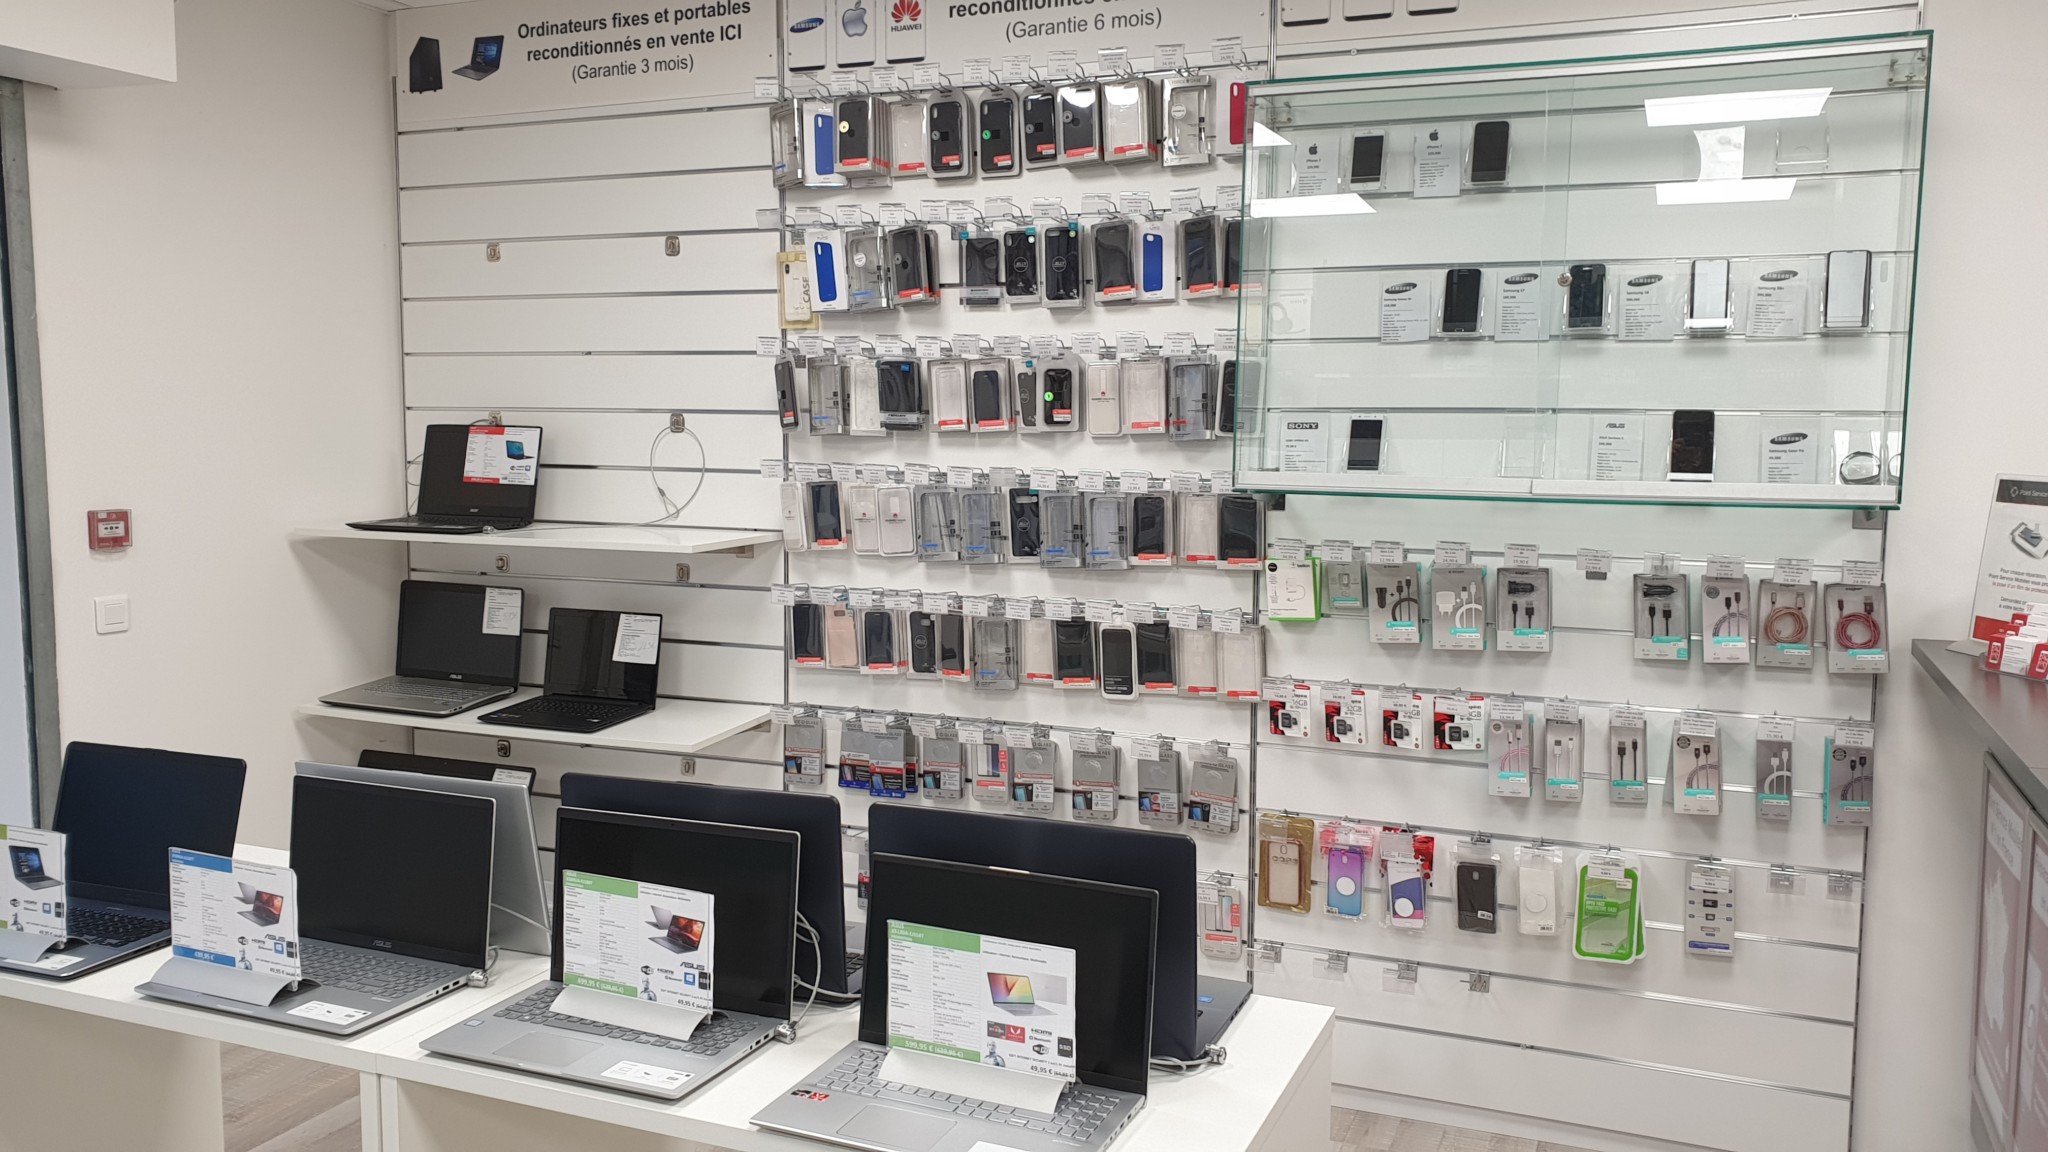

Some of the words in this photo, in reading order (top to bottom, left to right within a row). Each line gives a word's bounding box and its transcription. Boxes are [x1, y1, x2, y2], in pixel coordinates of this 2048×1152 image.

[518, 16, 607, 39] Ordinateurs
[612, 11, 649, 29] fixes
[654, 8, 669, 24] et
[674, 0, 751, 26] portables
[891, 24, 922, 32] HUAWEI
[1005, 16, 1088, 43] (Garantie
[1094, 13, 1105, 30] 6
[1111, 7, 1162, 30] mois)
[527, 36, 641, 62] reconditionnés
[646, 34, 666, 50] en
[670, 28, 715, 46] vente
[720, 24, 742, 42] ICI
[572, 60, 636, 84] (Garantie
[641, 58, 650, 74] 3
[654, 53, 694, 74] mois)
[802, 276, 810, 303] CASE
[264, 934, 285, 942] ASUS
[372, 940, 392, 948] ASUS
[680, 962, 705, 970] ASUS
[1031, 1028, 1052, 1036] HDMI
[905, 1040, 927, 1050] 599,95
[928, 1044, 934, 1052] €
[1030, 1065, 1047, 1074] 49,95
